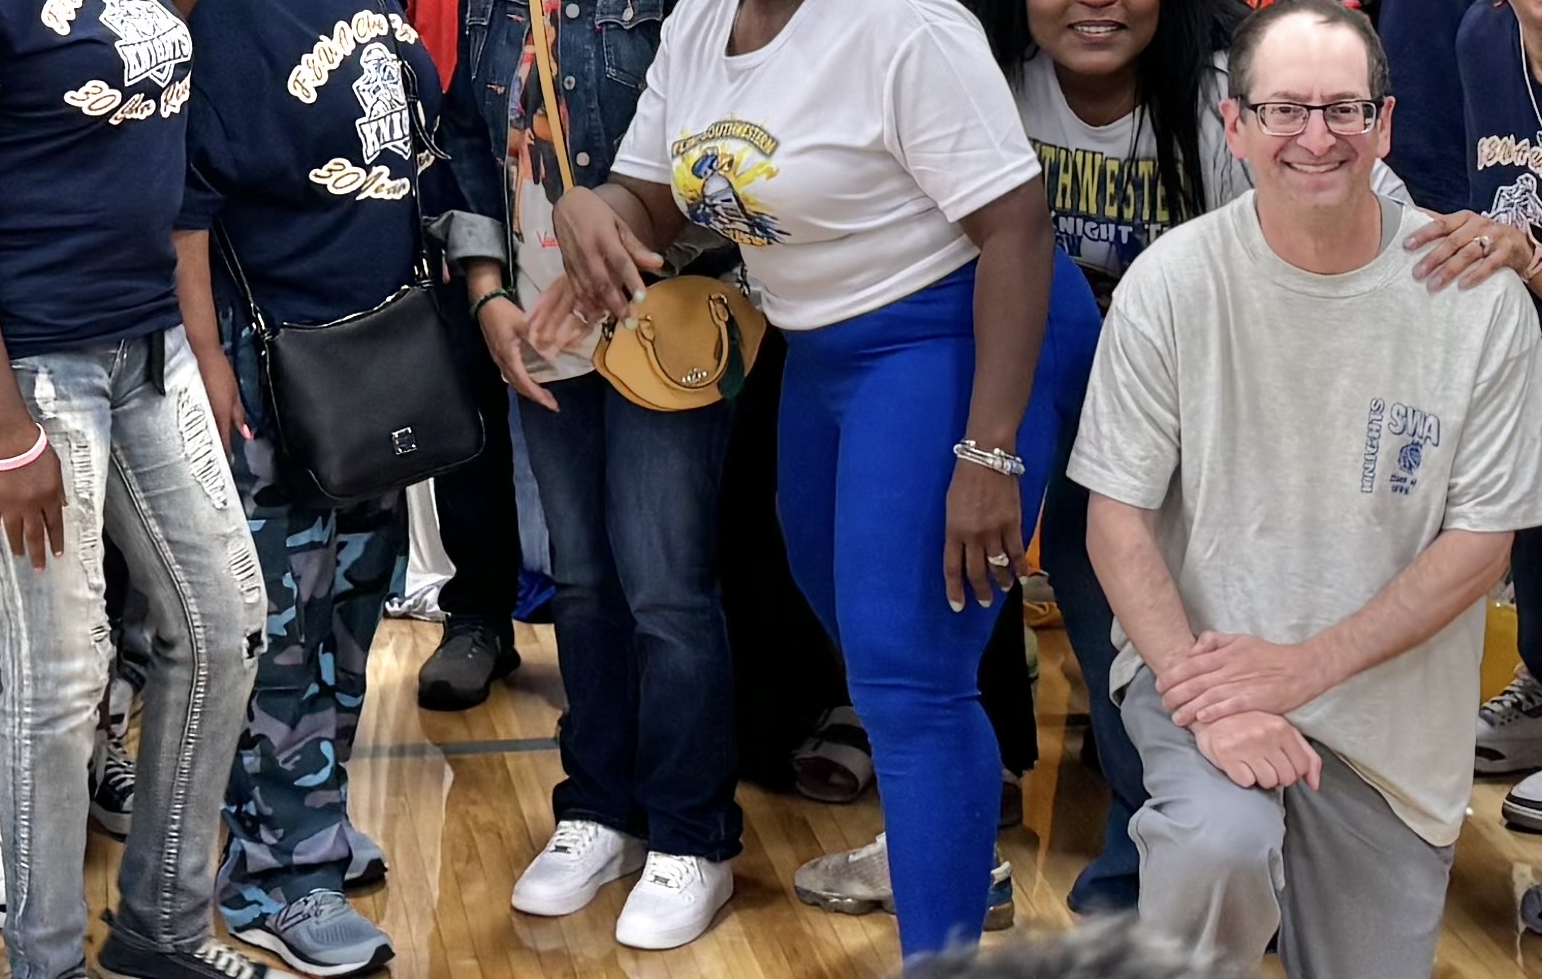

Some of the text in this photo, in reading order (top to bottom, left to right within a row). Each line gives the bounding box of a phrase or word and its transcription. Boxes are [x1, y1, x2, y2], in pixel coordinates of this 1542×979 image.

[121, 31, 191, 77] KNIGHTS
[68, 84, 118, 112] 30
[313, 160, 362, 190] 30
[1052, 214, 1134, 245] NIGHT
[1387, 401, 1441, 448] SWA
[1360, 397, 1385, 494] KNIGHTS
